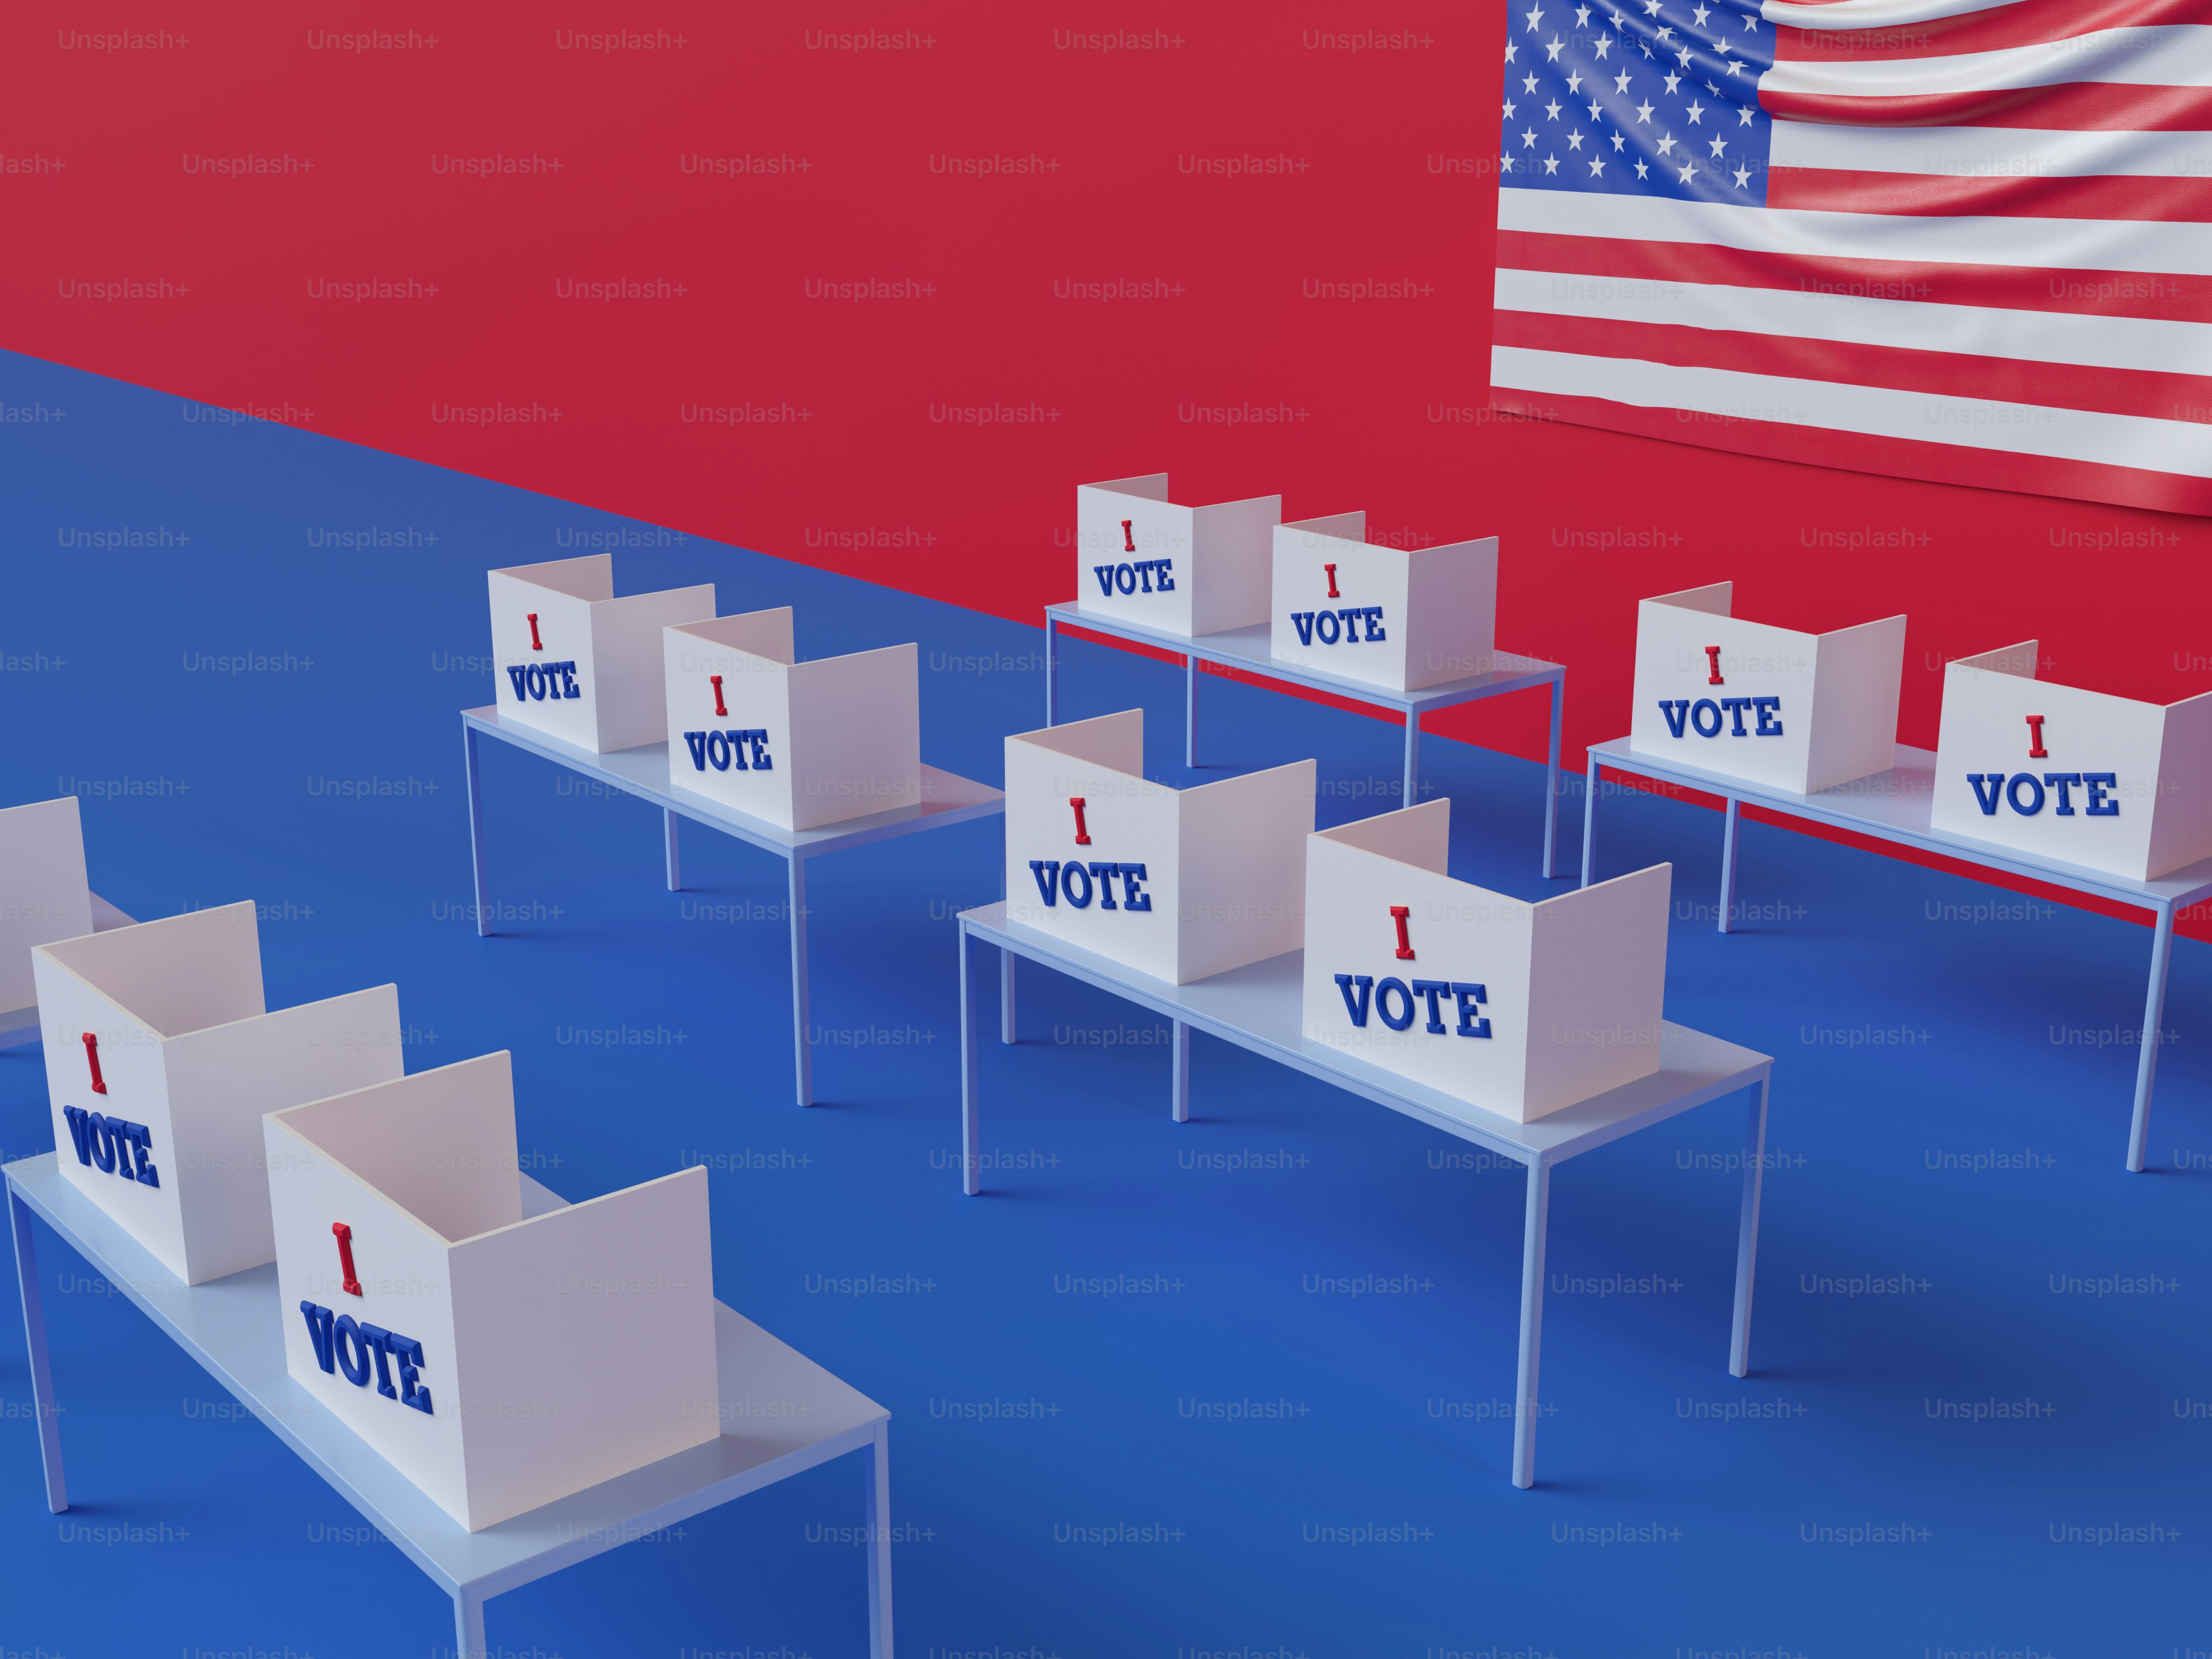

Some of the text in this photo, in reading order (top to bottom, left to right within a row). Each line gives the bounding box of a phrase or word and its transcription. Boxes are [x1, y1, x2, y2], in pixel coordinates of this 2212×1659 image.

[1121, 520, 1135, 551] I
[1094, 559, 1175, 596] VOTE
[1324, 564, 1339, 597] I
[528, 614, 542, 650] I
[1291, 607, 1385, 645] VOTE
[507, 661, 580, 701] VOTE
[1705, 646, 1723, 684] I
[711, 676, 727, 716] I
[1658, 697, 1782, 738] VOTE
[2026, 716, 2047, 758] I
[684, 729, 772, 771] VOTE
[1967, 773, 2119, 816] VOTE
[1070, 798, 1091, 844] I
[1029, 860, 1151, 911] VOTE
[1390, 906, 1415, 959] I
[1334, 974, 1491, 1039] VOTE
[82, 1033, 106, 1094] I
[64, 1105, 160, 1188] VOTE
[332, 1223, 362, 1296] I
[300, 1300, 433, 1415] VOTE
